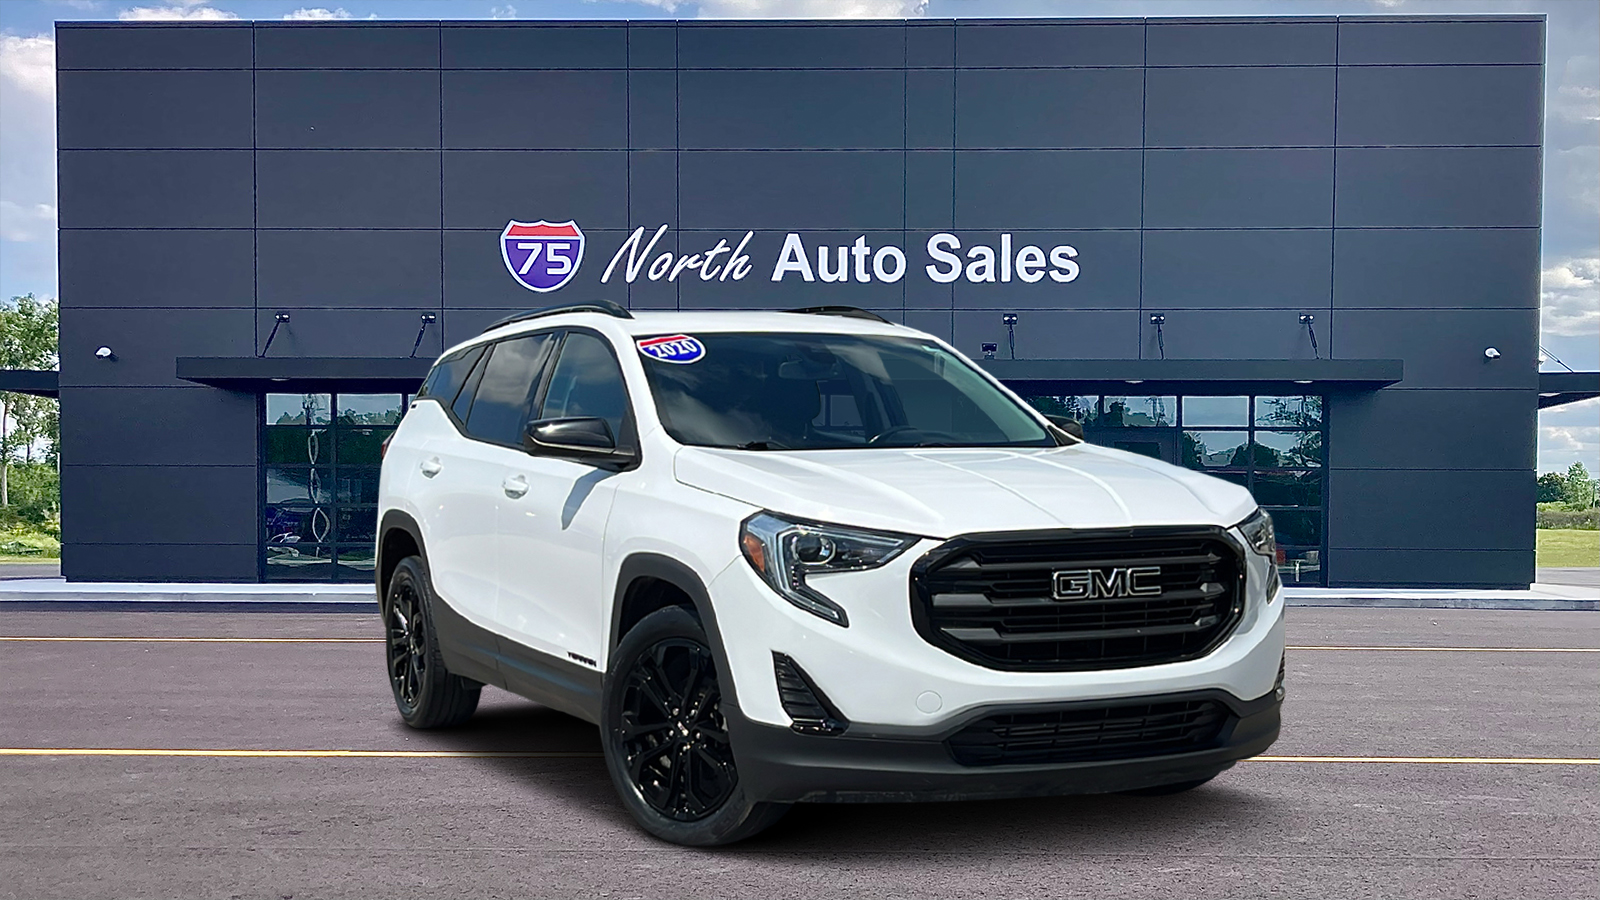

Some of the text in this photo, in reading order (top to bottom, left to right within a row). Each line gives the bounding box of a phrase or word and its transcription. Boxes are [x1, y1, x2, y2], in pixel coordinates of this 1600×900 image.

[517, 224, 1080, 284] 75 North Auto Sales
[648, 341, 698, 358] 2020
[1051, 566, 1162, 600] GMC
